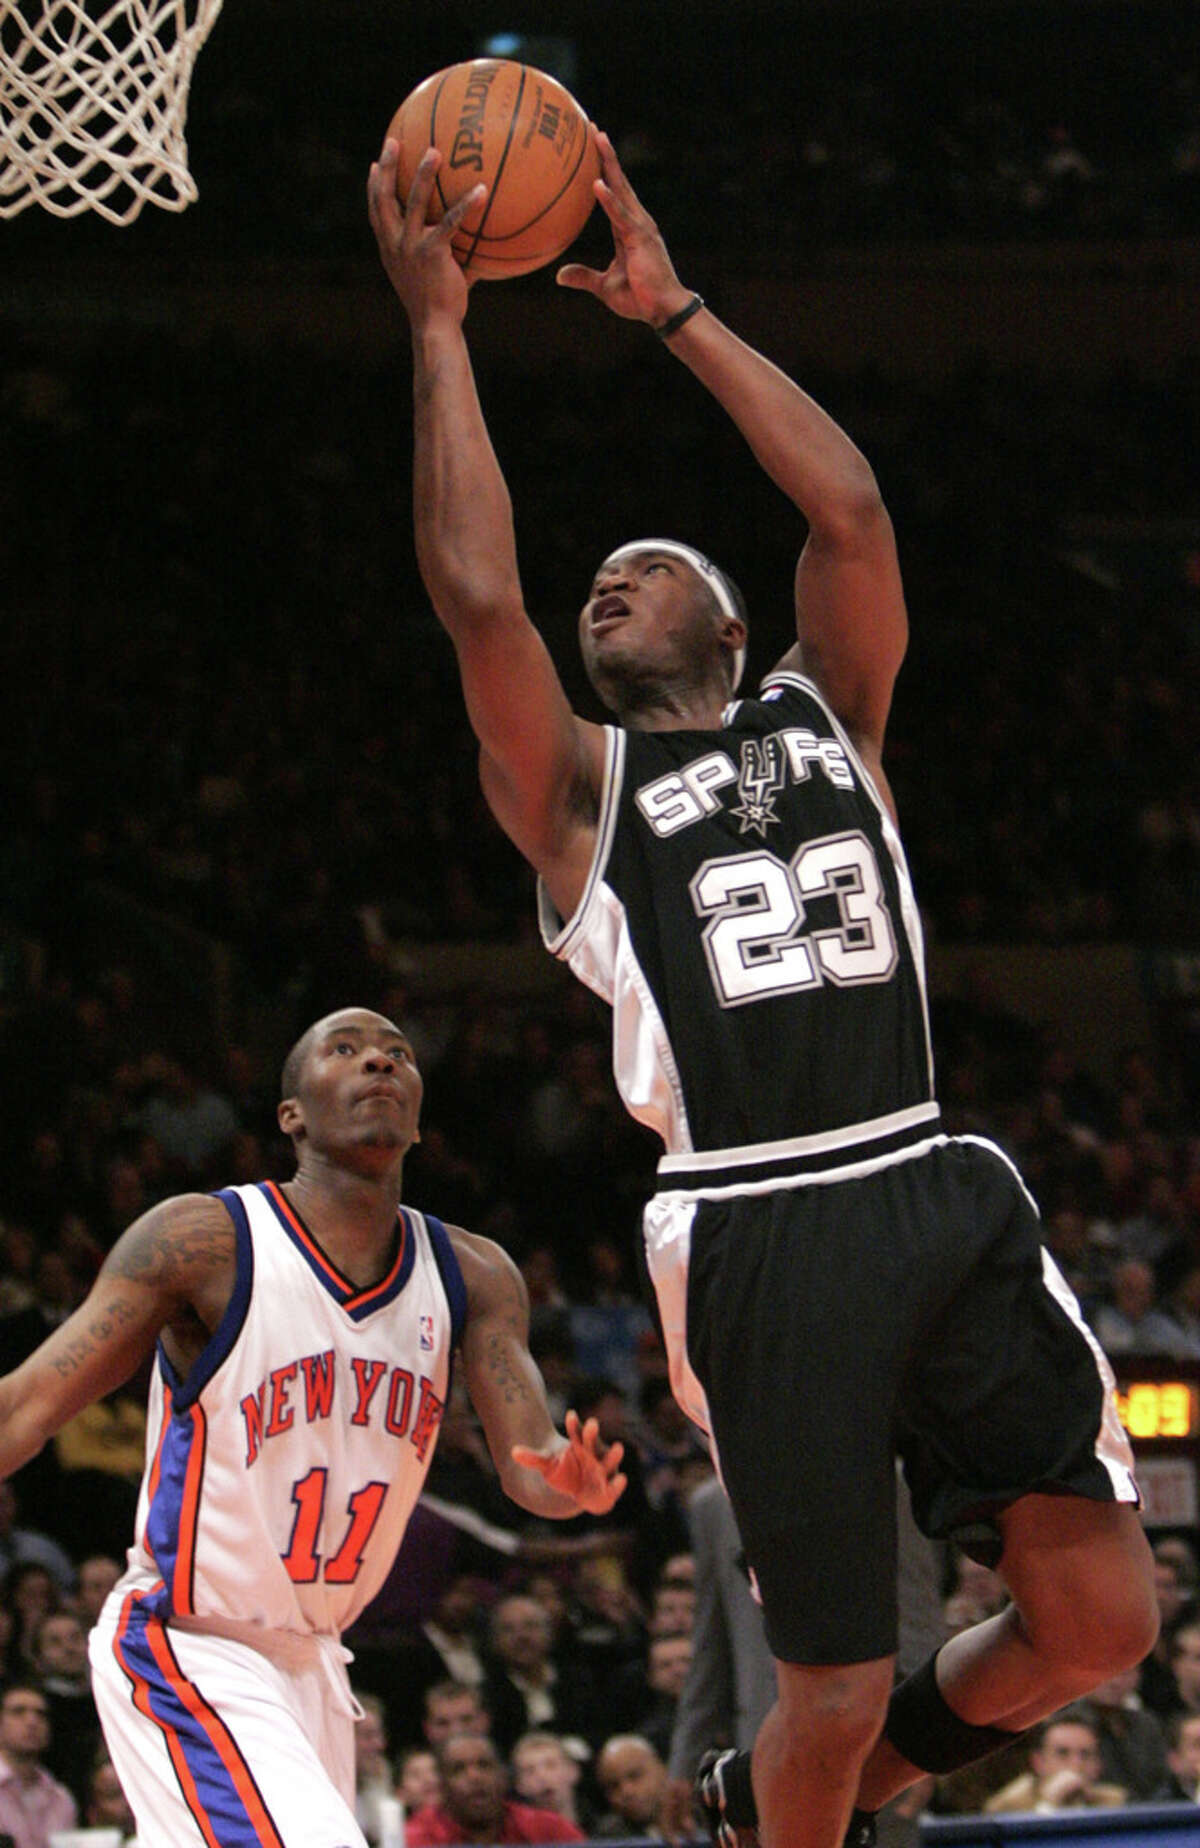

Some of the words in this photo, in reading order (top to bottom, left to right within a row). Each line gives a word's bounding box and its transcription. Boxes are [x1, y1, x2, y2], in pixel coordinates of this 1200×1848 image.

[634, 727, 856, 838] SPURS
[688, 829, 899, 1009] 23
[240, 1350, 336, 1469] NEW
[280, 1466, 390, 1585] 11
